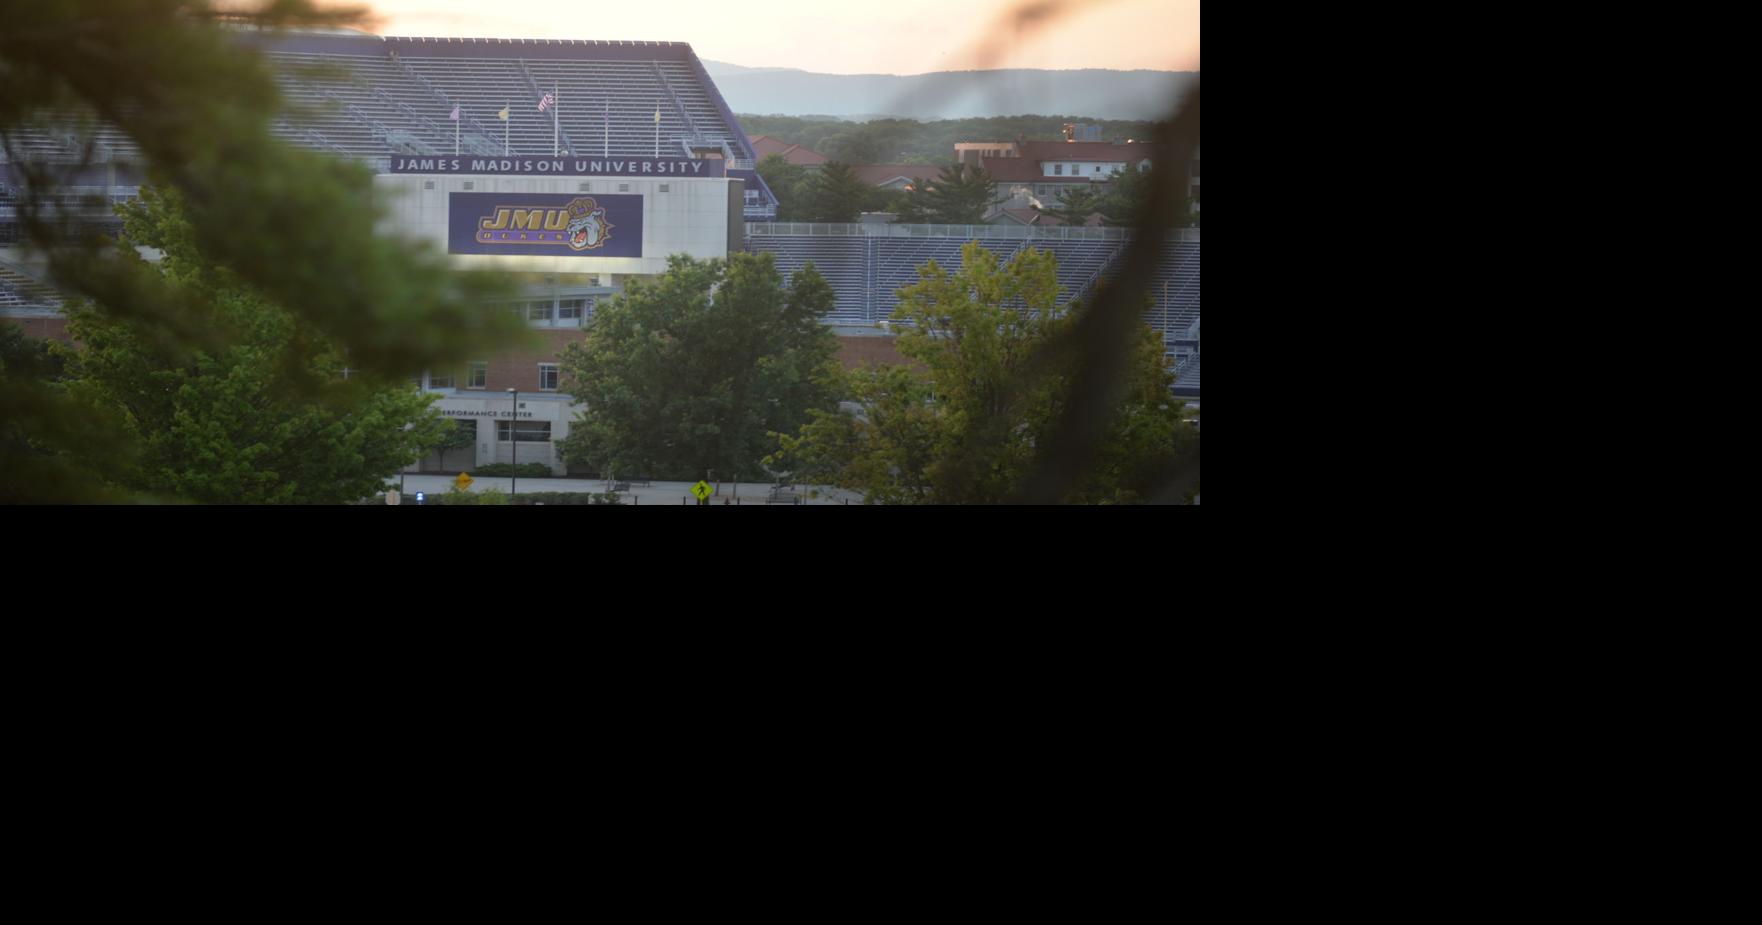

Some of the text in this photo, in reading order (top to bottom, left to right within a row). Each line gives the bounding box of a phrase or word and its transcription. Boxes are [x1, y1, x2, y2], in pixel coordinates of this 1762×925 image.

[397, 159, 702, 173] JAMES MADISON UNIVERSITY
[482, 208, 571, 231] JMU
[439, 410, 498, 418] ERFORMANCE
